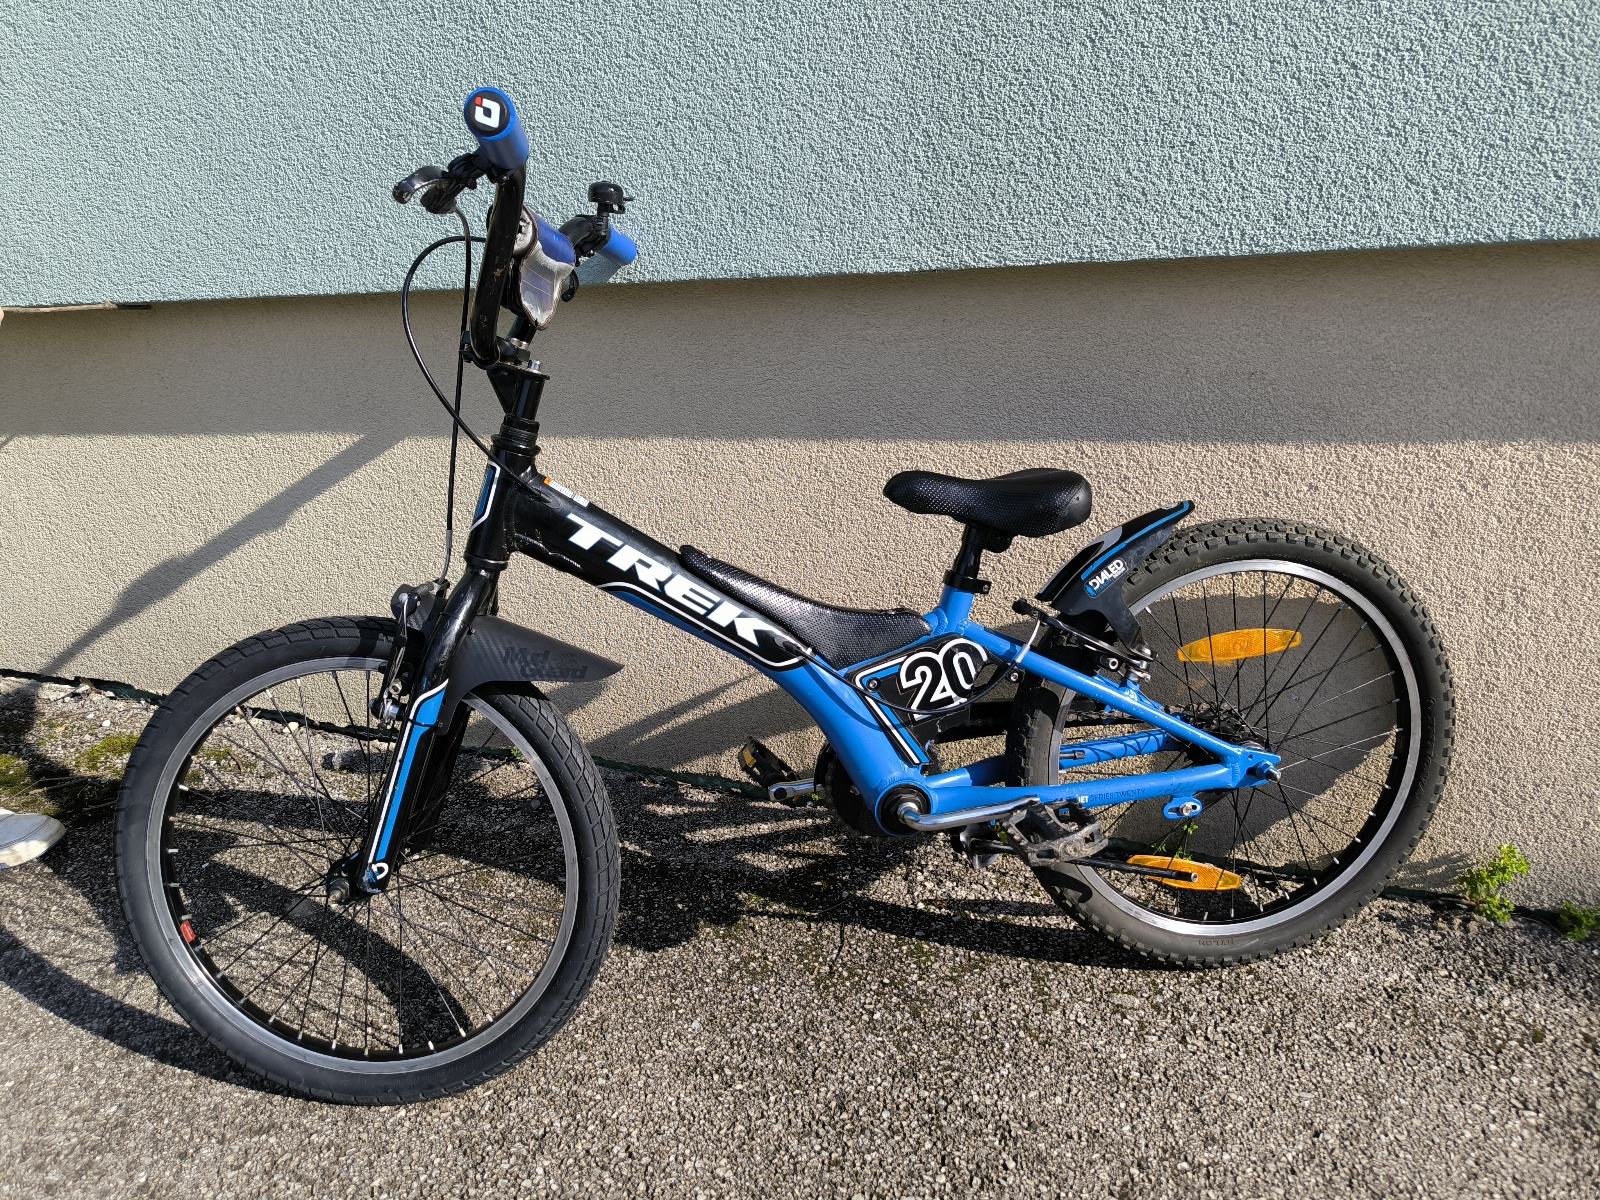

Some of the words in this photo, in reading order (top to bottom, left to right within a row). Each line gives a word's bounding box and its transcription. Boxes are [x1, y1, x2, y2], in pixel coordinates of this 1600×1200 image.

[567, 513, 796, 647] TREK
[1089, 559, 1125, 590] DIALED
[900, 638, 988, 721] 20
